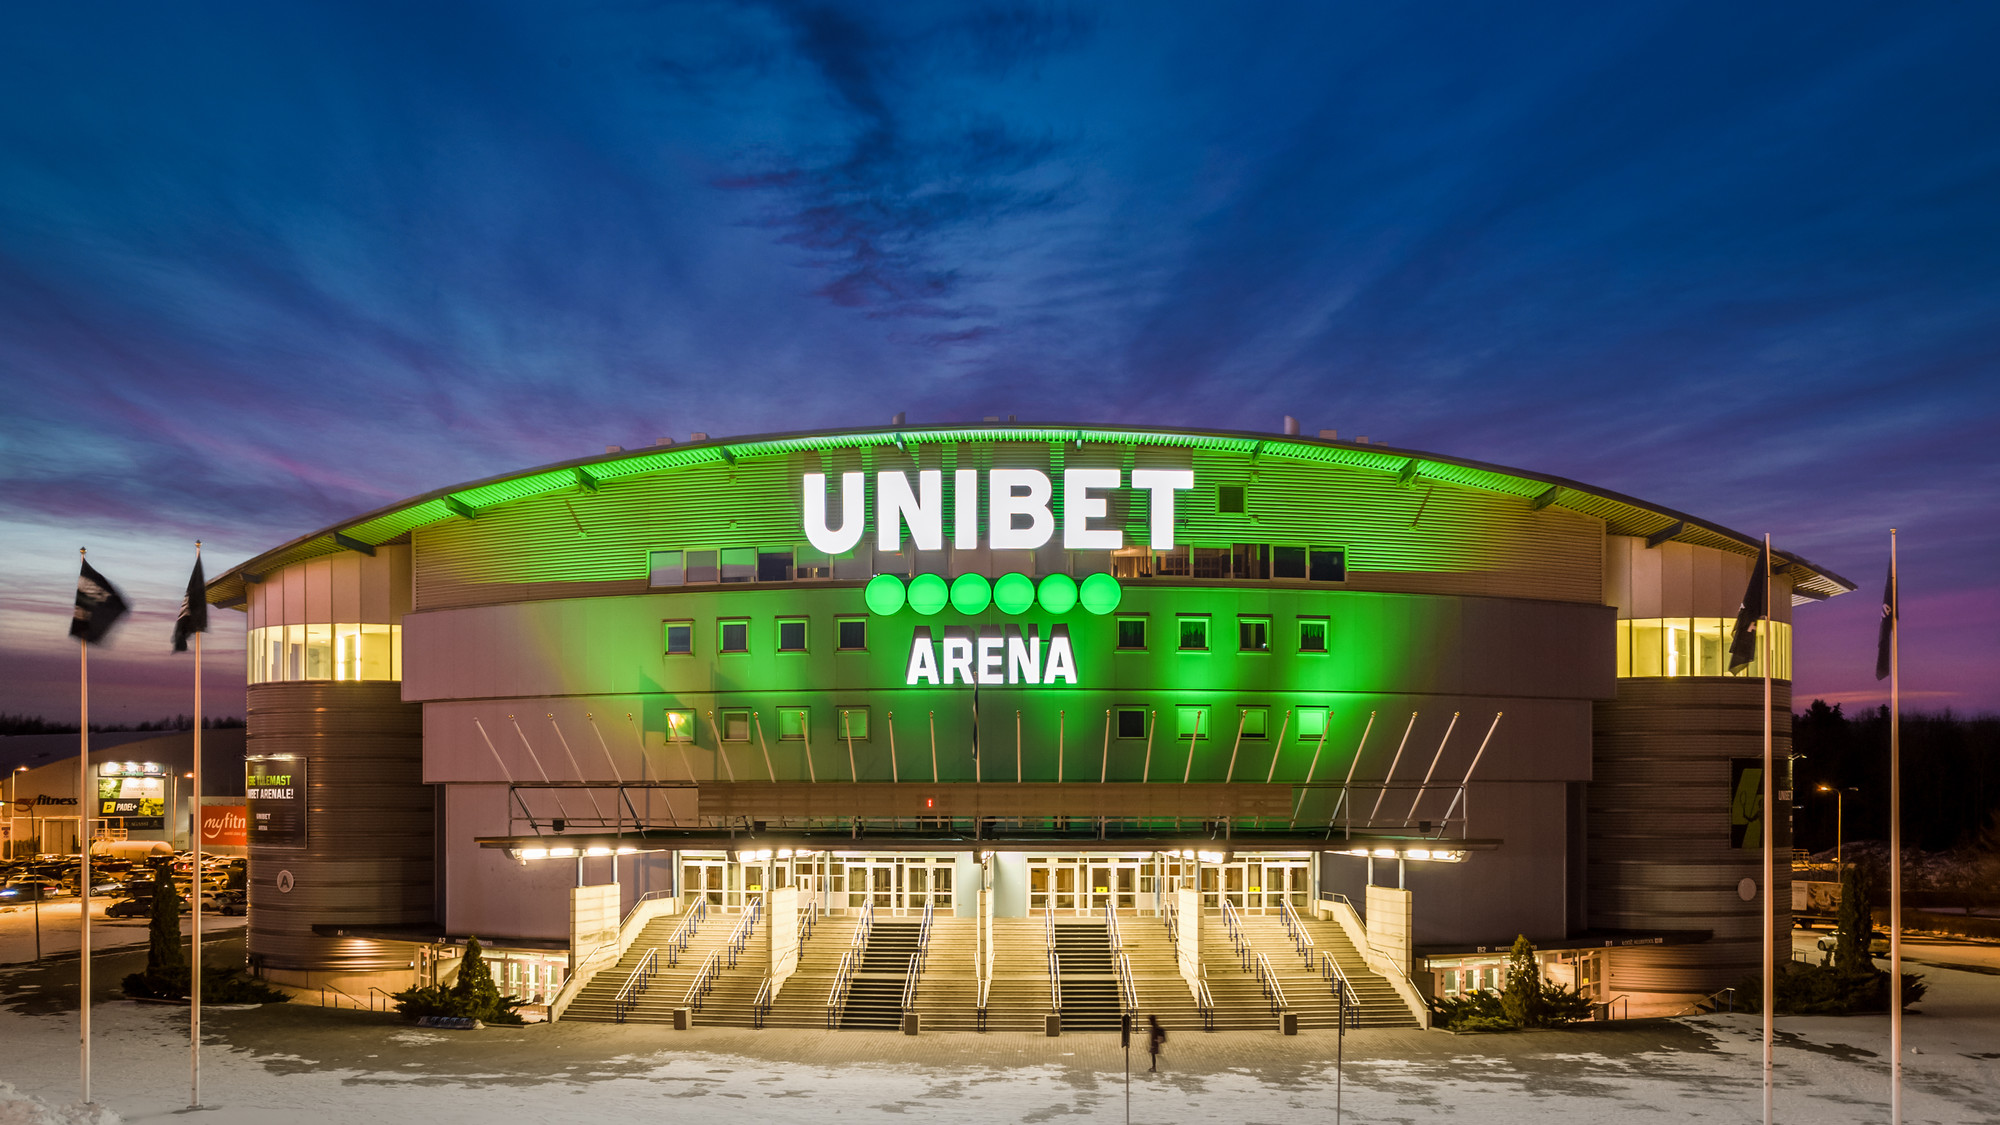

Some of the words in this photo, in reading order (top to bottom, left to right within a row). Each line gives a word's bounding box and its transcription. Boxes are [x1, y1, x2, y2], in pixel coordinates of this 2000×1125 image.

[803, 468, 1194, 555] UNIBET
[905, 636, 1078, 685] ARENA
[256, 775, 291, 786] TULEMAST
[260, 788, 294, 799] ARENALE!
[116, 803, 137, 812] PADEL+
[280, 876, 290, 888] A
